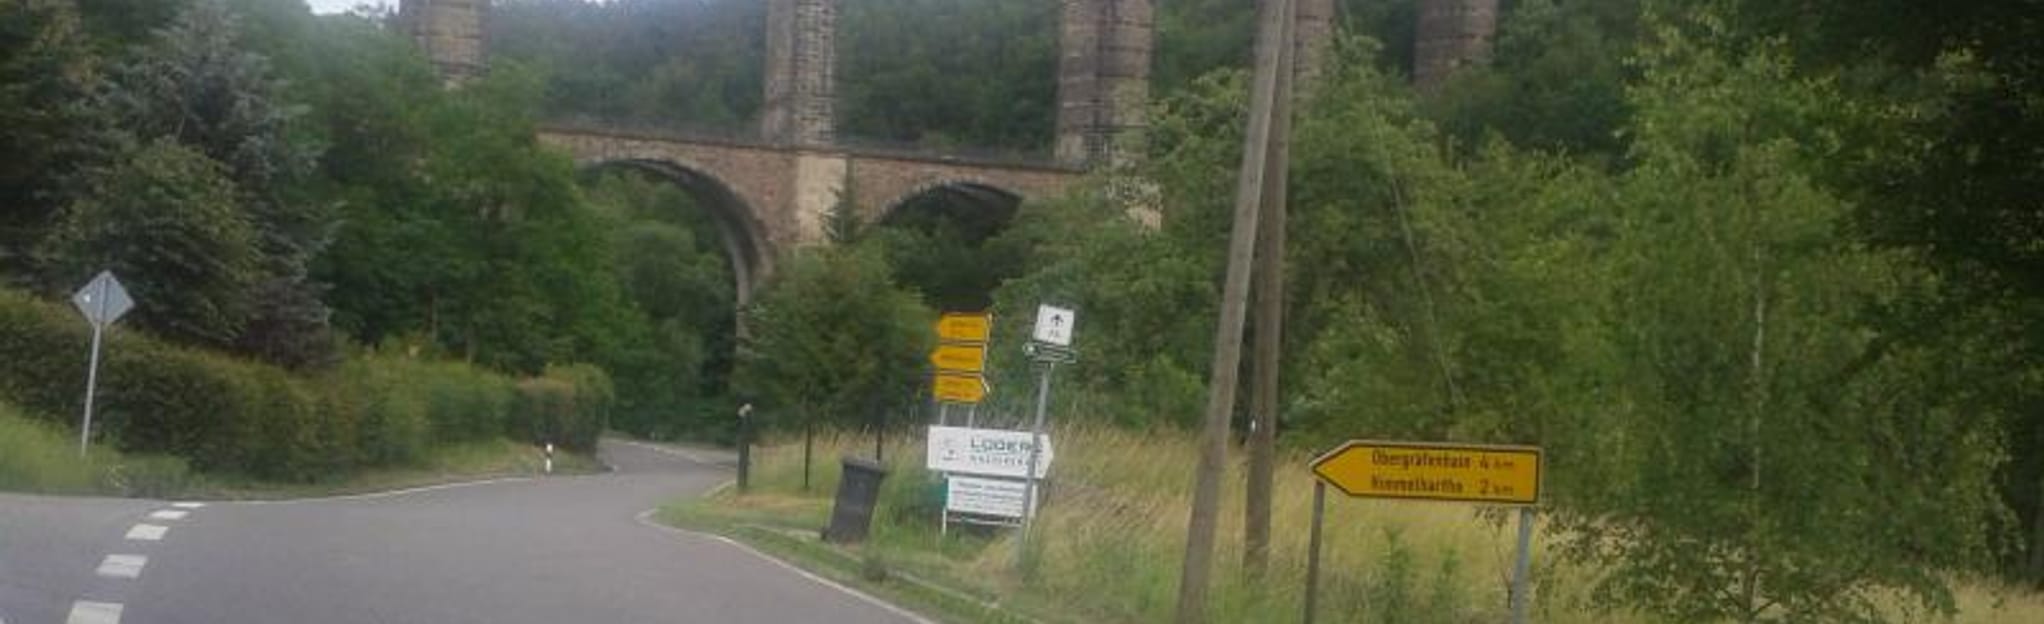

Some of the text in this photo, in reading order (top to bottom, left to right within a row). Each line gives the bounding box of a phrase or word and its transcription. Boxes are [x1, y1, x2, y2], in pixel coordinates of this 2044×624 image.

[1479, 454, 1489, 468] 4
[1494, 456, 1514, 468] km
[1479, 479, 1489, 494] 2
[1494, 482, 1514, 496] km
